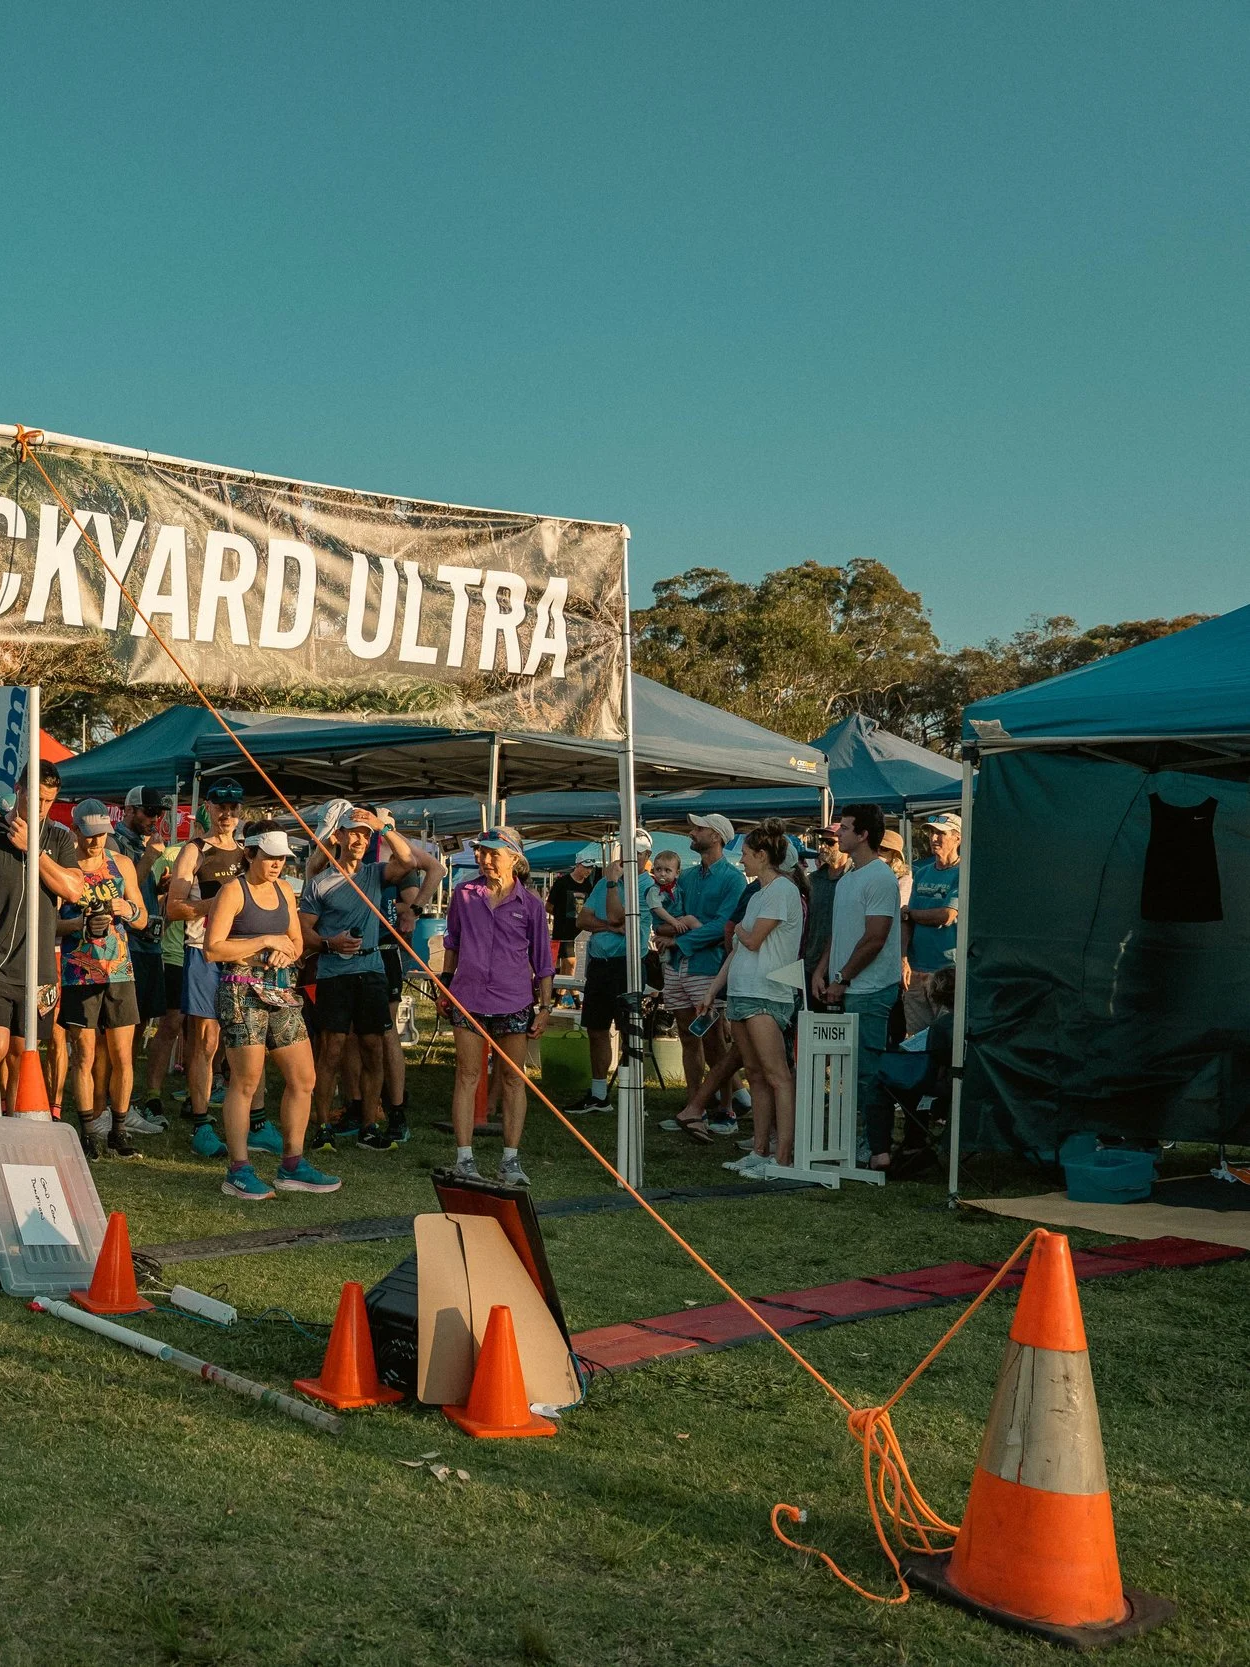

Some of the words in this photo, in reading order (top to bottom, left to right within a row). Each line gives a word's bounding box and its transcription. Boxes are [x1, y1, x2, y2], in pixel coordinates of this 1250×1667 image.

[346, 551, 568, 678] ULTRA
[106, 880, 120, 899] TRAIL
[813, 1026, 845, 1041] FINISH
